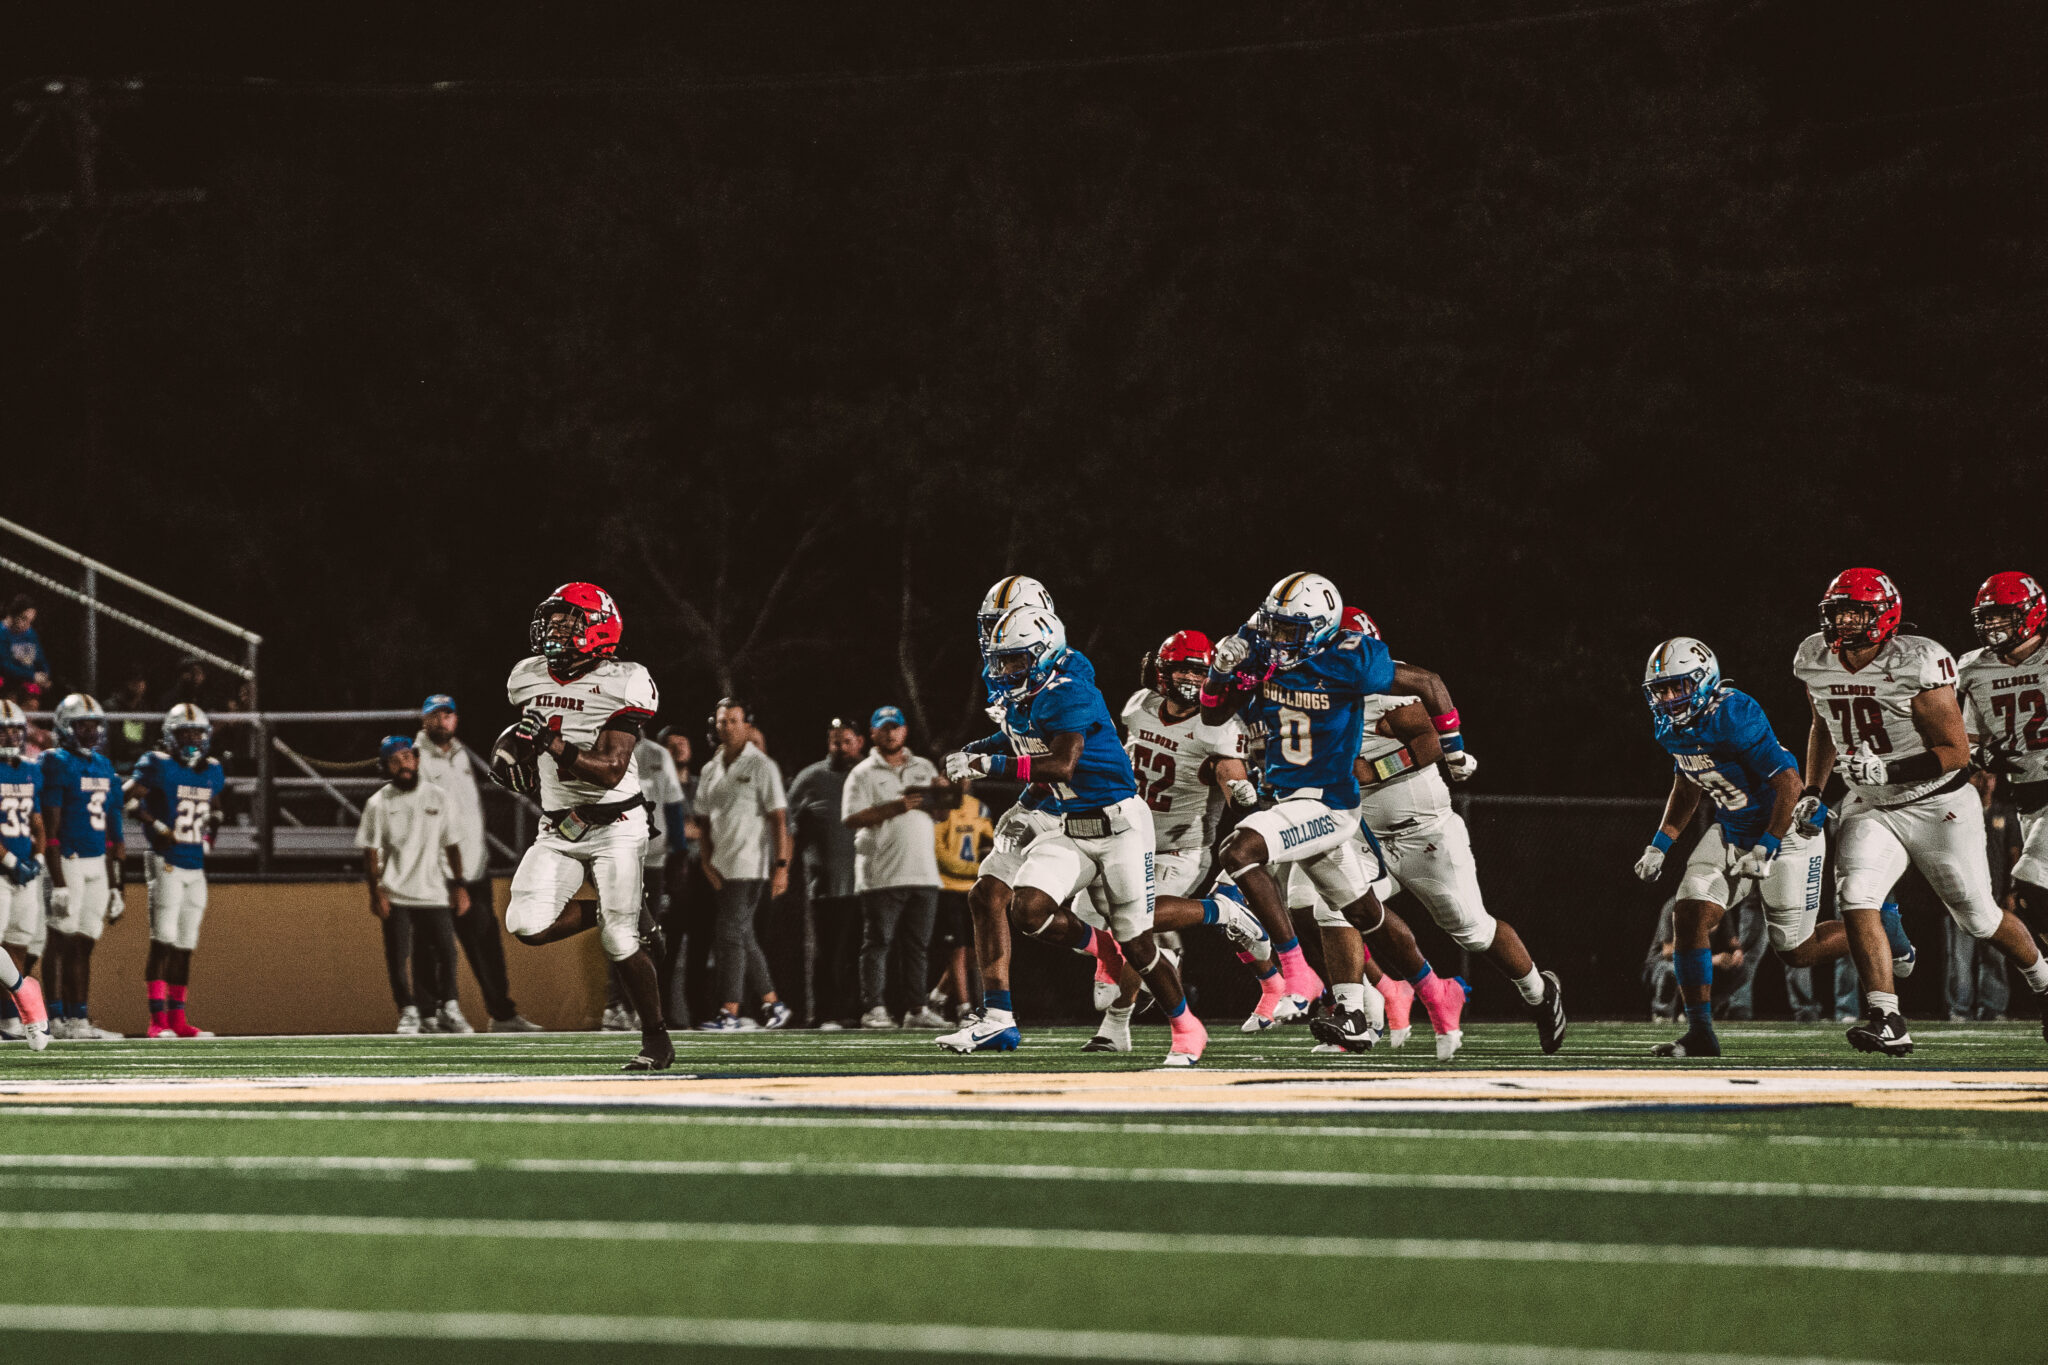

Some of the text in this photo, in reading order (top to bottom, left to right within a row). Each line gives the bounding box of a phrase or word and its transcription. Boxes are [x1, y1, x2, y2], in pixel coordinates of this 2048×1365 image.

[1323, 589, 1335, 611] 0
[1034, 616, 1053, 637] 11
[1690, 642, 1713, 664] 30
[1263, 680, 1331, 711] BULLDOGS
[1829, 684, 1877, 697] KILGORE
[1991, 674, 2040, 690] KILGORE
[535, 694, 585, 712] KILGORE
[1827, 696, 1894, 756] 78
[1990, 689, 2048, 752] 72
[1139, 728, 1179, 753] KILGORE
[1278, 706, 1313, 767] 0
[1133, 743, 1177, 813] 52
[1279, 814, 1336, 850] BULLDOGS
[960, 834, 975, 862] 4
[1144, 851, 1155, 914] BULLDOGS
[1805, 855, 1822, 911] BULLDOGS
